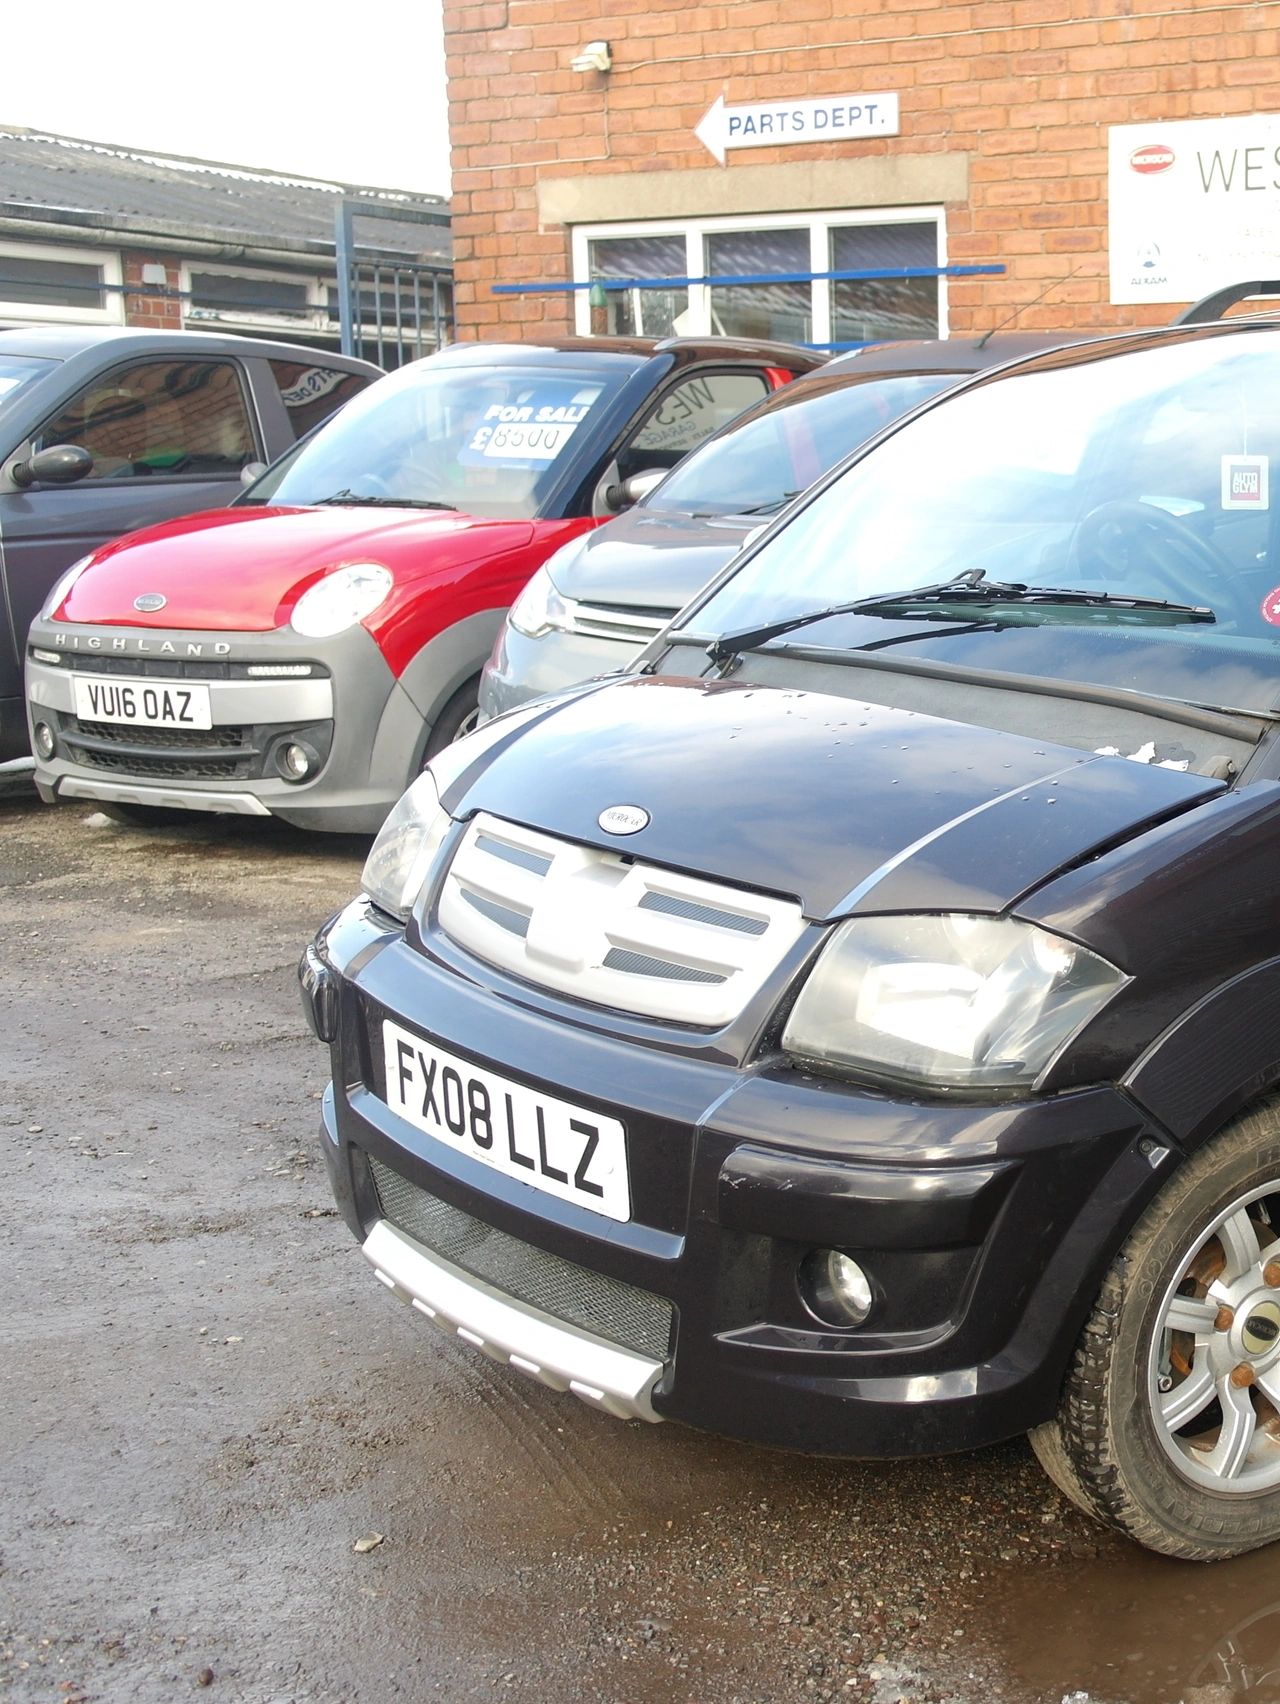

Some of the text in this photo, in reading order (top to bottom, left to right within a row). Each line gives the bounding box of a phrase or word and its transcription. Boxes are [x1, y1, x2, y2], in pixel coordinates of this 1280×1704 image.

[729, 105, 886, 136] PARTS DEPT.
[484, 404, 534, 422] FOR
[1232, 472, 1258, 483] AUTO
[1232, 482, 1258, 494] GLYM
[55, 634, 232, 656] HIGHLAND
[87, 684, 194, 722] VU16 OAZ
[397, 1038, 604, 1199] FX08 LLZ
